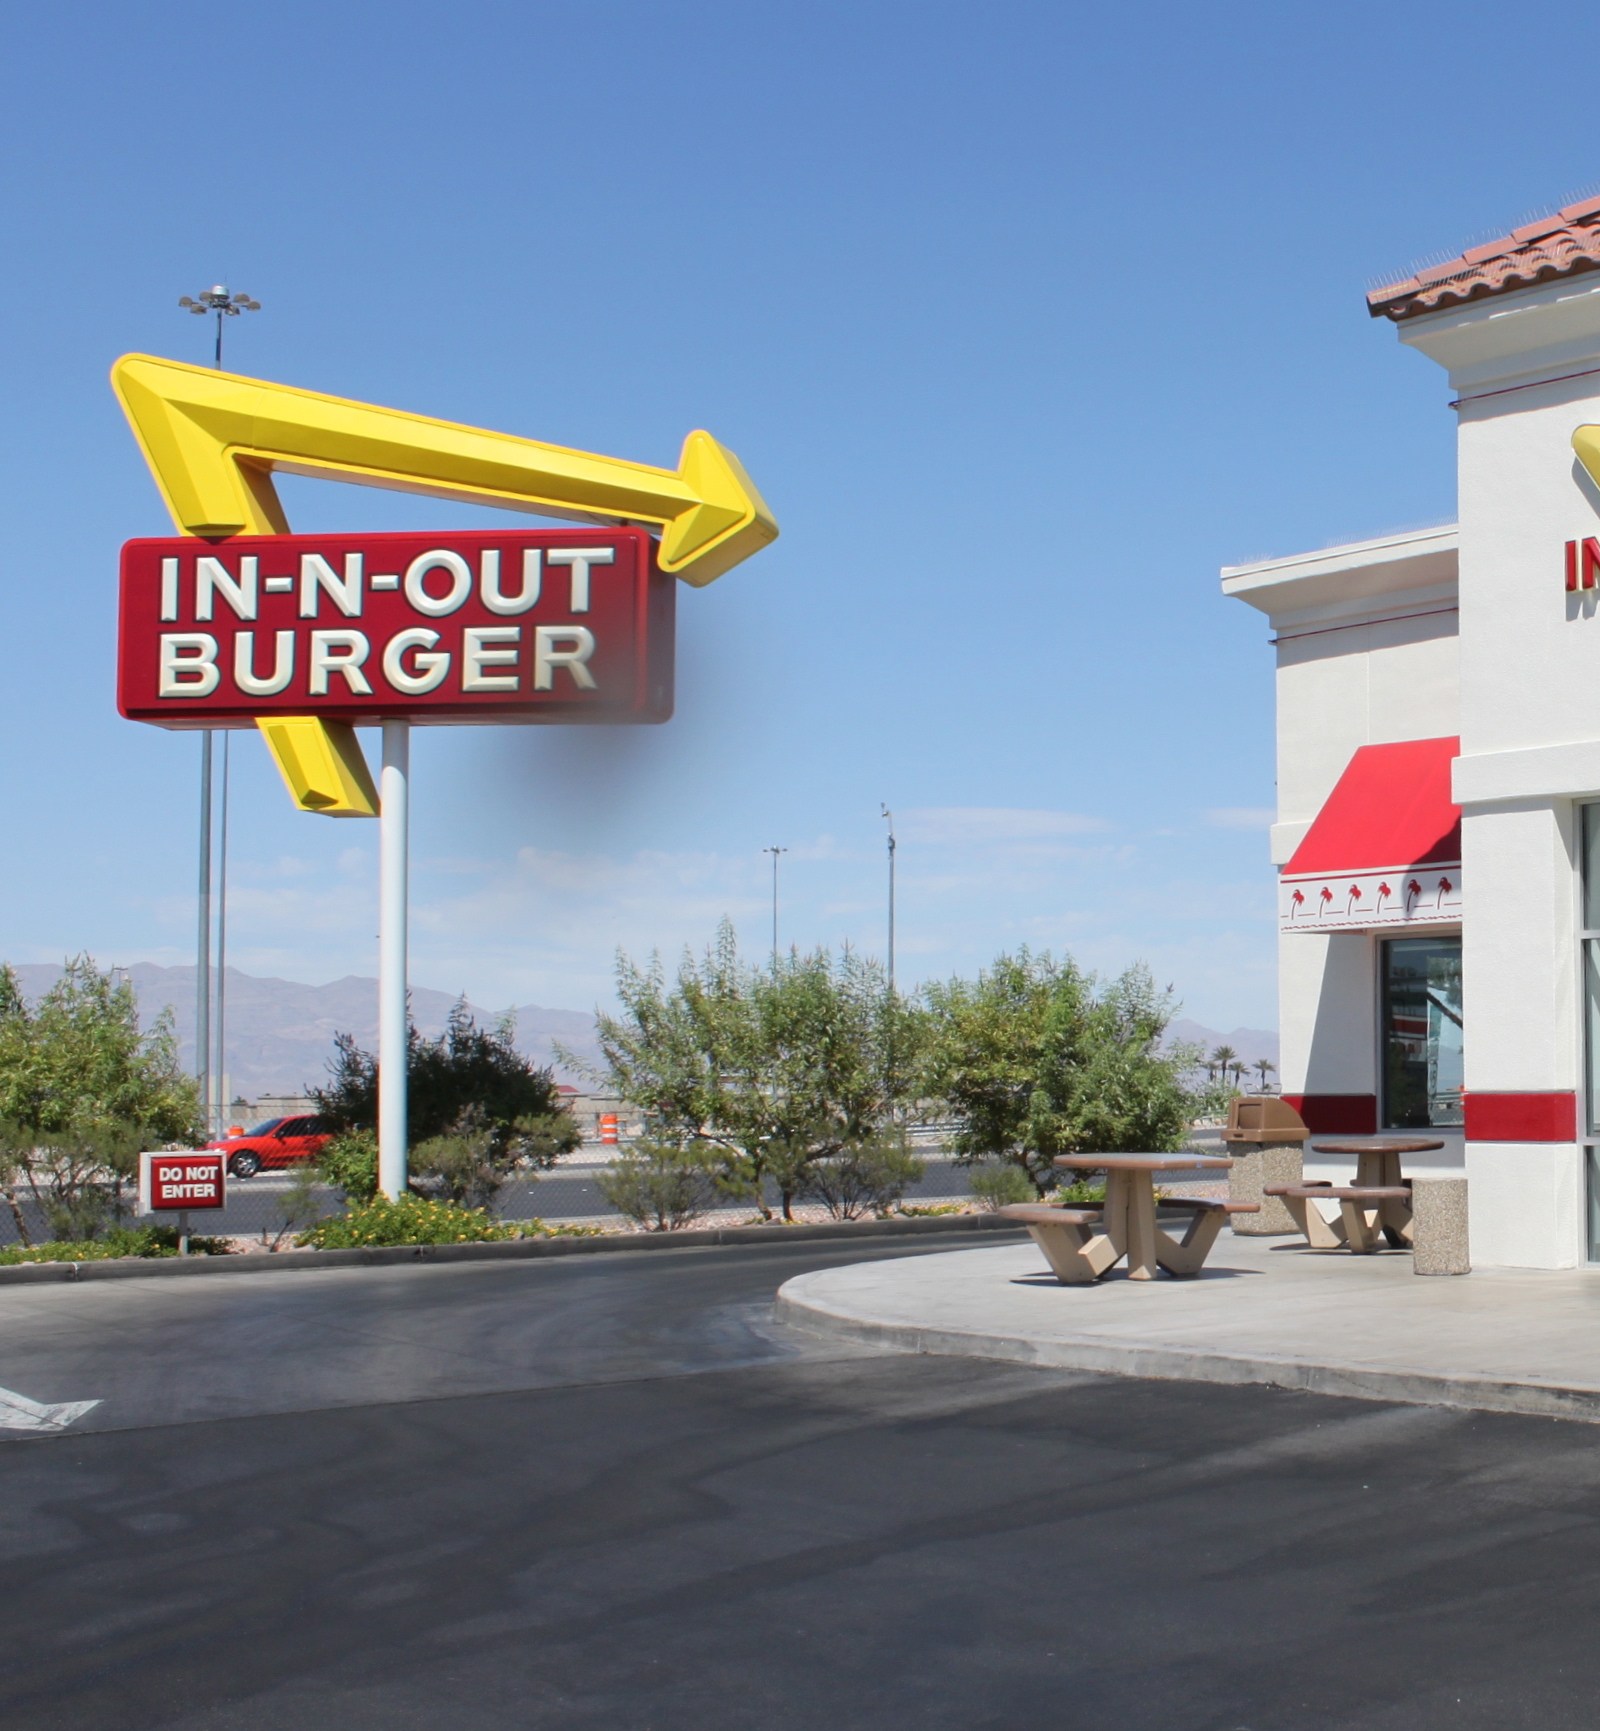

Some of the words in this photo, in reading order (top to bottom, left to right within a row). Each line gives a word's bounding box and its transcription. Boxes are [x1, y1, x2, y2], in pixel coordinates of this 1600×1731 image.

[160, 546, 615, 622] IN-N-OUT
[158, 625, 598, 699] BURGER
[159, 1167, 183, 1182] DO
[185, 1166, 219, 1181] NOT
[161, 1183, 216, 1199] ENTER
